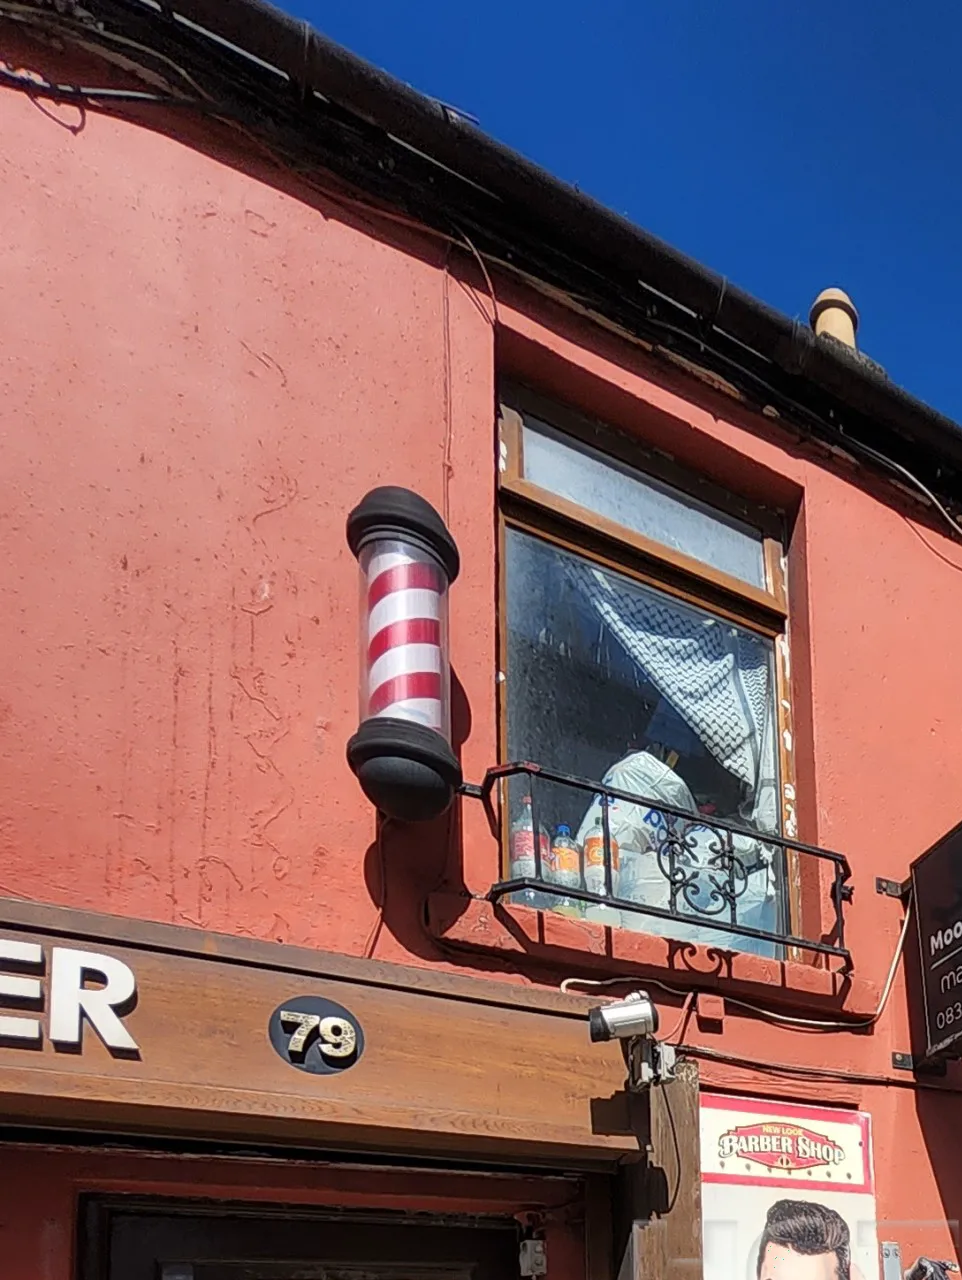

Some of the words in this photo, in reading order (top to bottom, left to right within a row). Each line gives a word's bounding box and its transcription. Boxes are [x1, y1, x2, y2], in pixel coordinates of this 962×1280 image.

[936, 1003, 962, 1029] 083
[280, 1010, 357, 1064] 79
[762, 1125, 780, 1135] NEW
[719, 1135, 793, 1158] BARBER
[797, 1135, 845, 1165] SHOP
